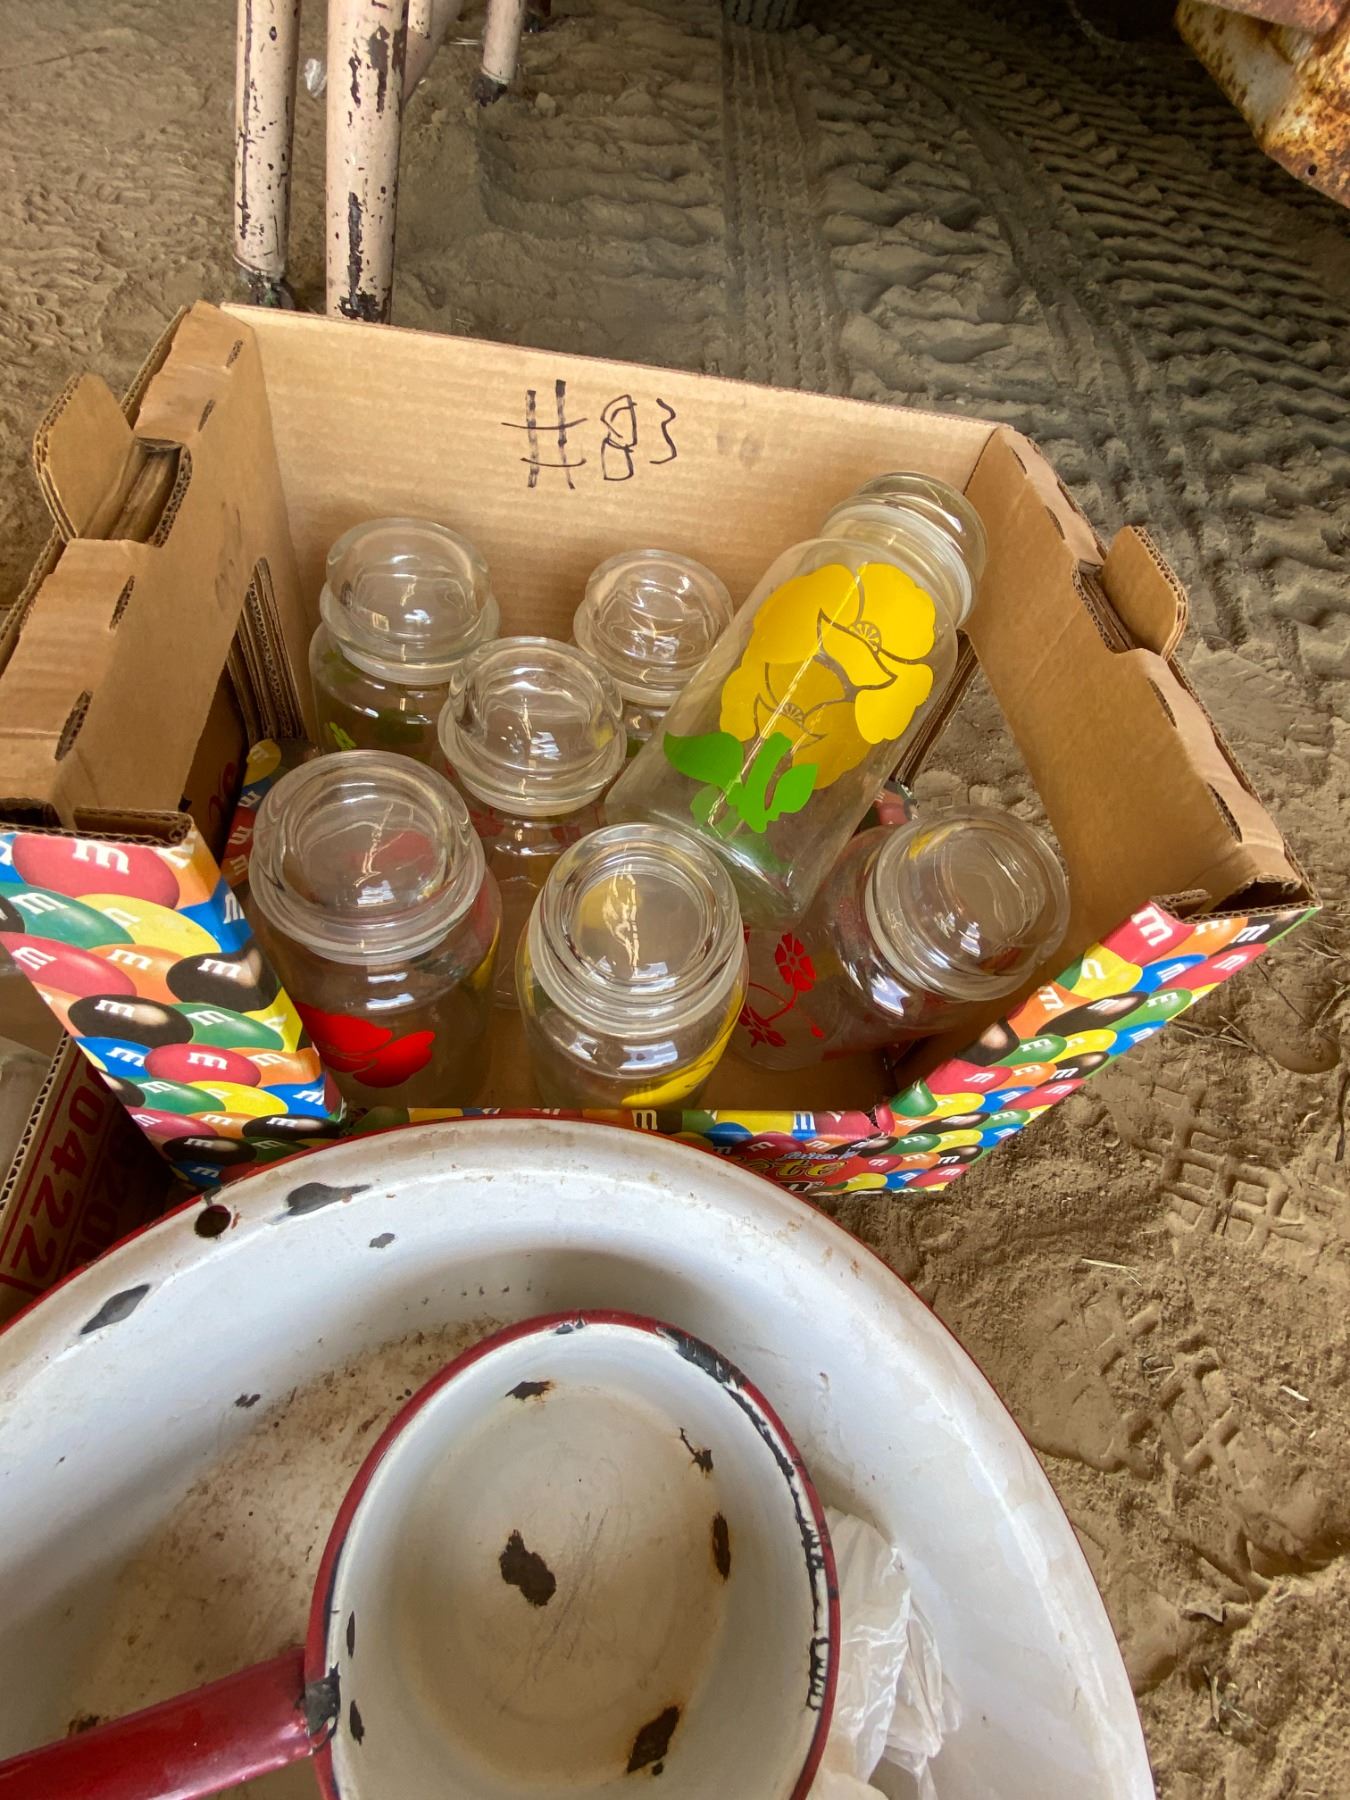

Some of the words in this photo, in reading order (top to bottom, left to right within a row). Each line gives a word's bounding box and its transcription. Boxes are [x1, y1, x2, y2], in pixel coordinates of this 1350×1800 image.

[72, 838, 129, 875] m
[1130, 906, 1173, 947] m
[107, 949, 152, 970] m
[197, 958, 241, 979] m
[94, 1000, 135, 1018] m
[187, 1052, 228, 1070] m
